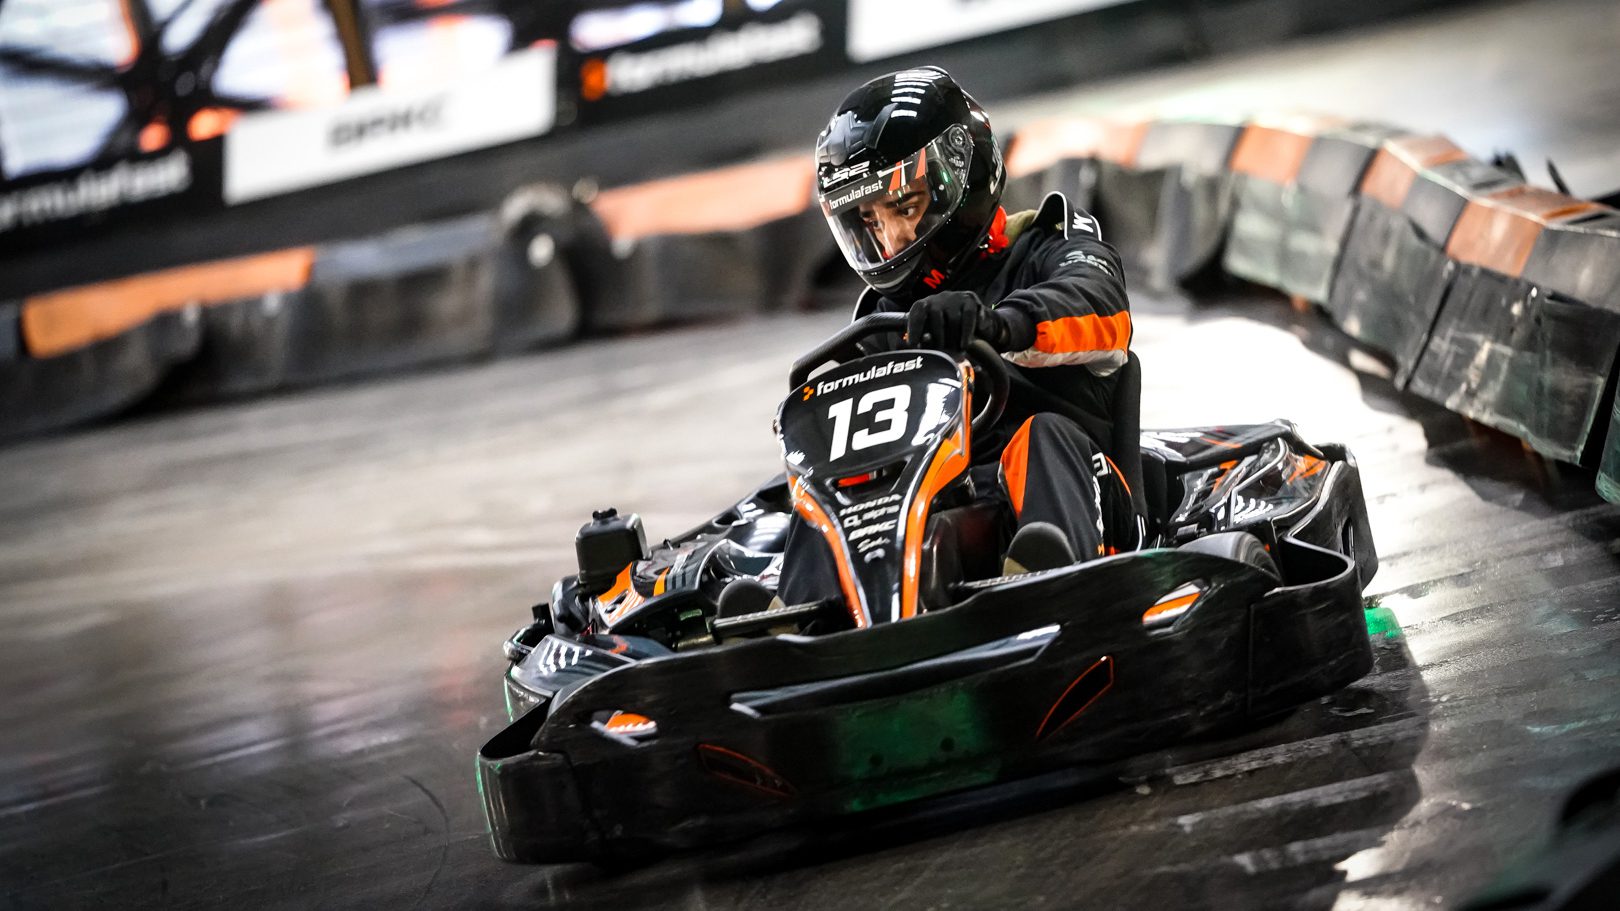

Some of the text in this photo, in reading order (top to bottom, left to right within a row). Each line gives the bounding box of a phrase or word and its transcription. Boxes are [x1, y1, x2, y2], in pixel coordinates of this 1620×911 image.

[829, 180, 883, 210] formulafast
[816, 356, 924, 396] formulafast
[828, 384, 911, 462] 13
[839, 493, 902, 517] HONDA
